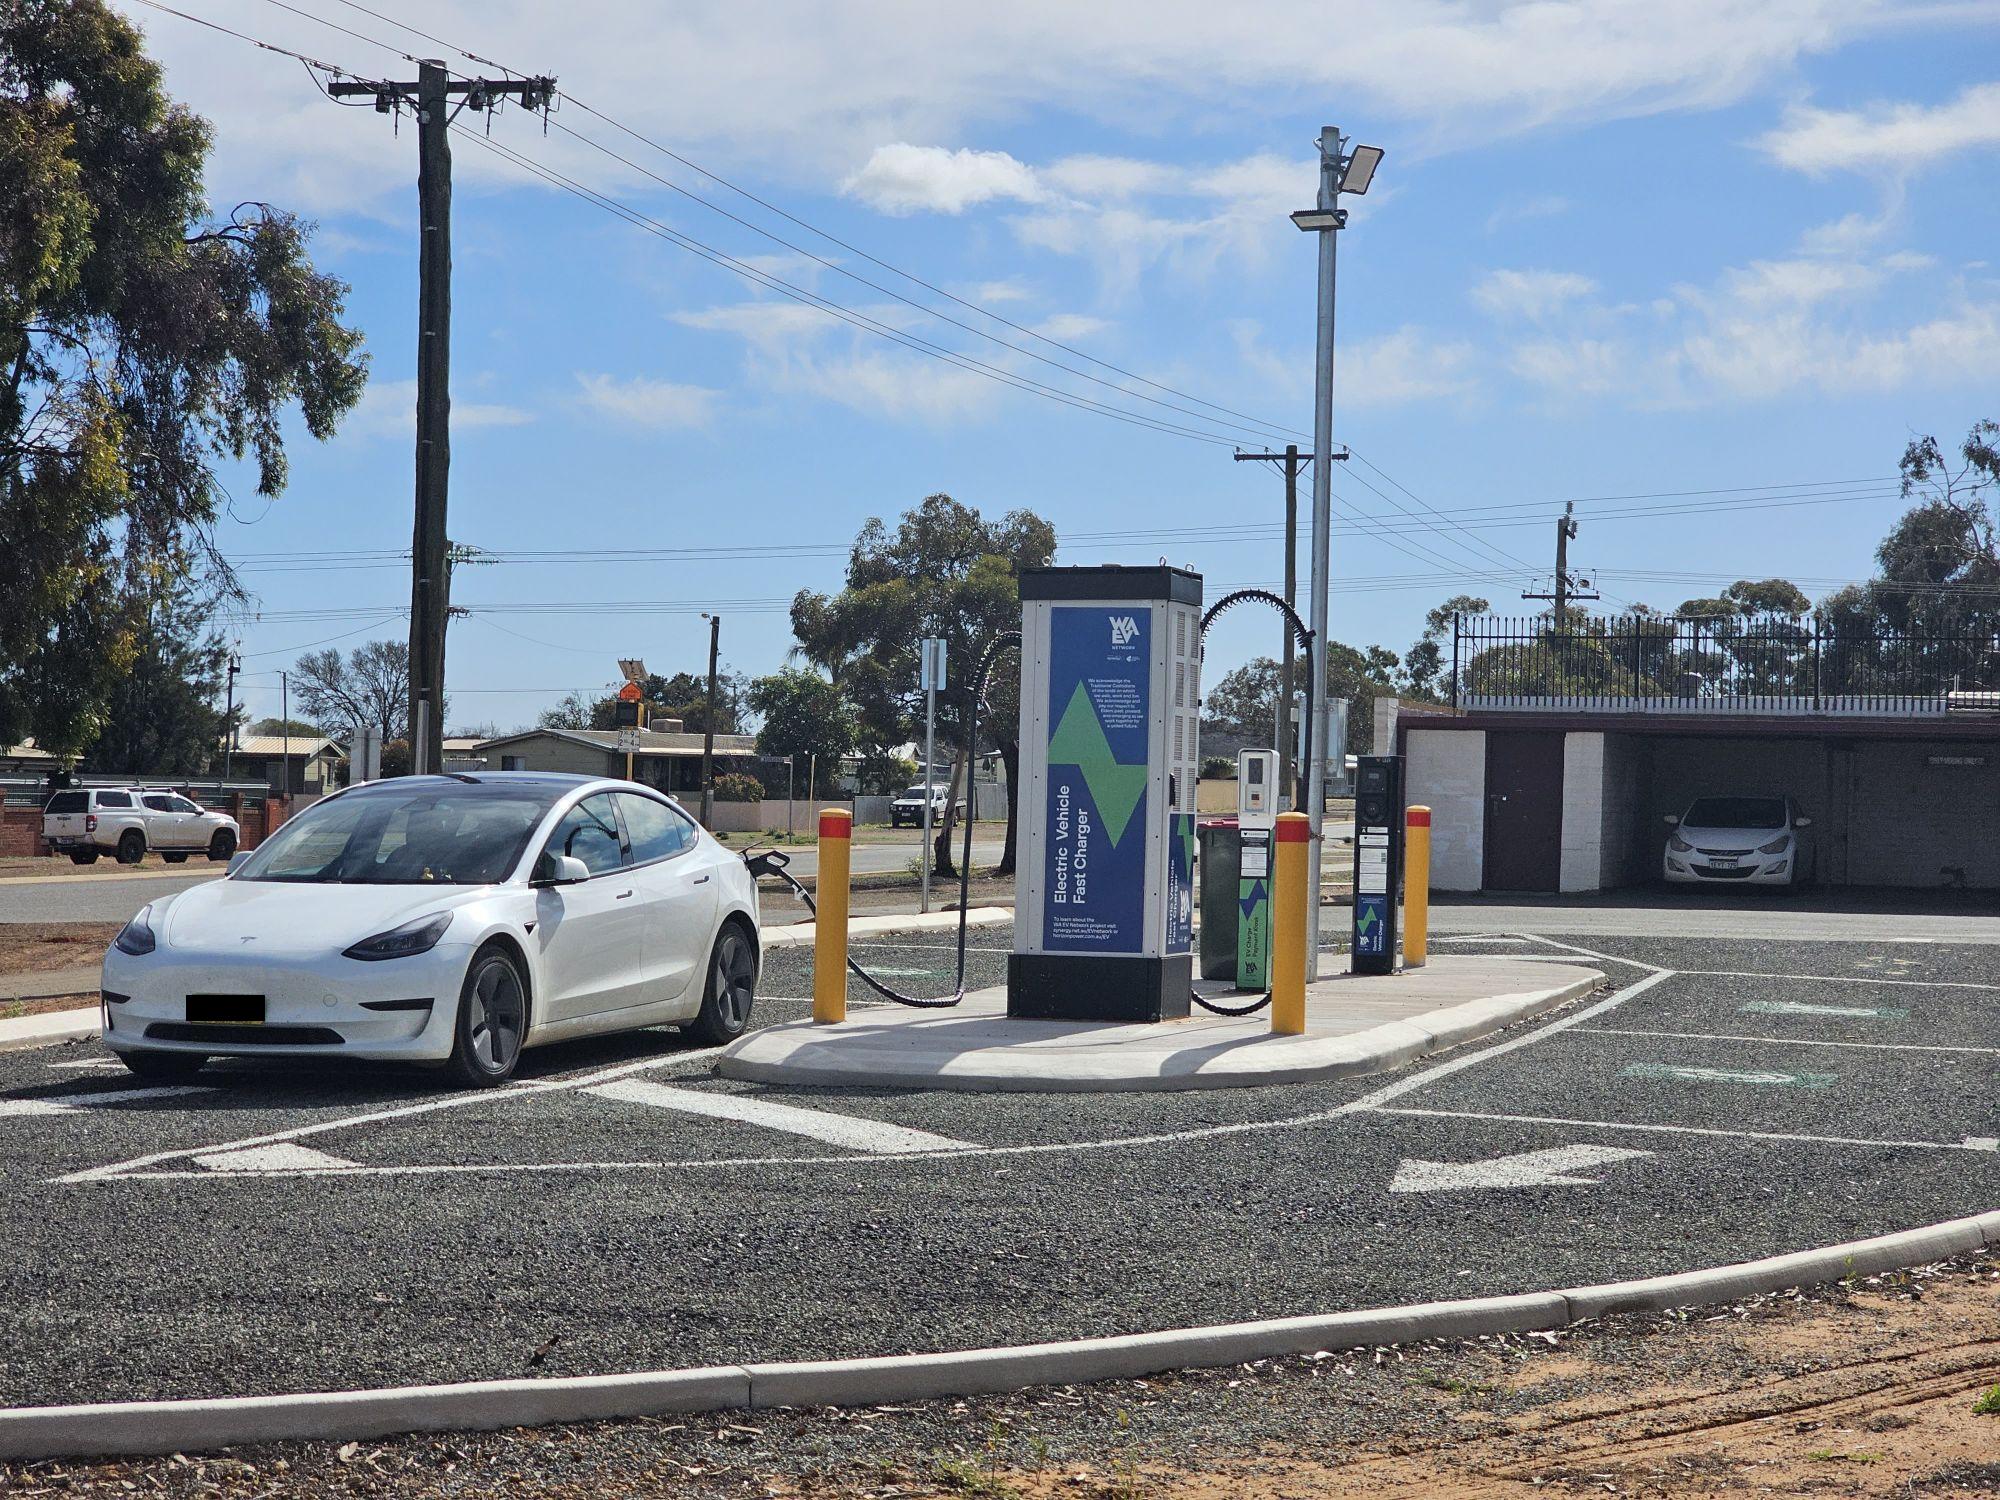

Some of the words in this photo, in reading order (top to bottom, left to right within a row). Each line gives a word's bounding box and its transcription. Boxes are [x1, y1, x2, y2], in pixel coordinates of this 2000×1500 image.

[1109, 617, 1140, 636] WA
[1112, 630, 1133, 644] EV
[1056, 785, 1070, 841] Vehicle
[1074, 808, 1090, 870] Charger
[1055, 847, 1068, 904] Electric
[1073, 872, 1086, 904] Fast
